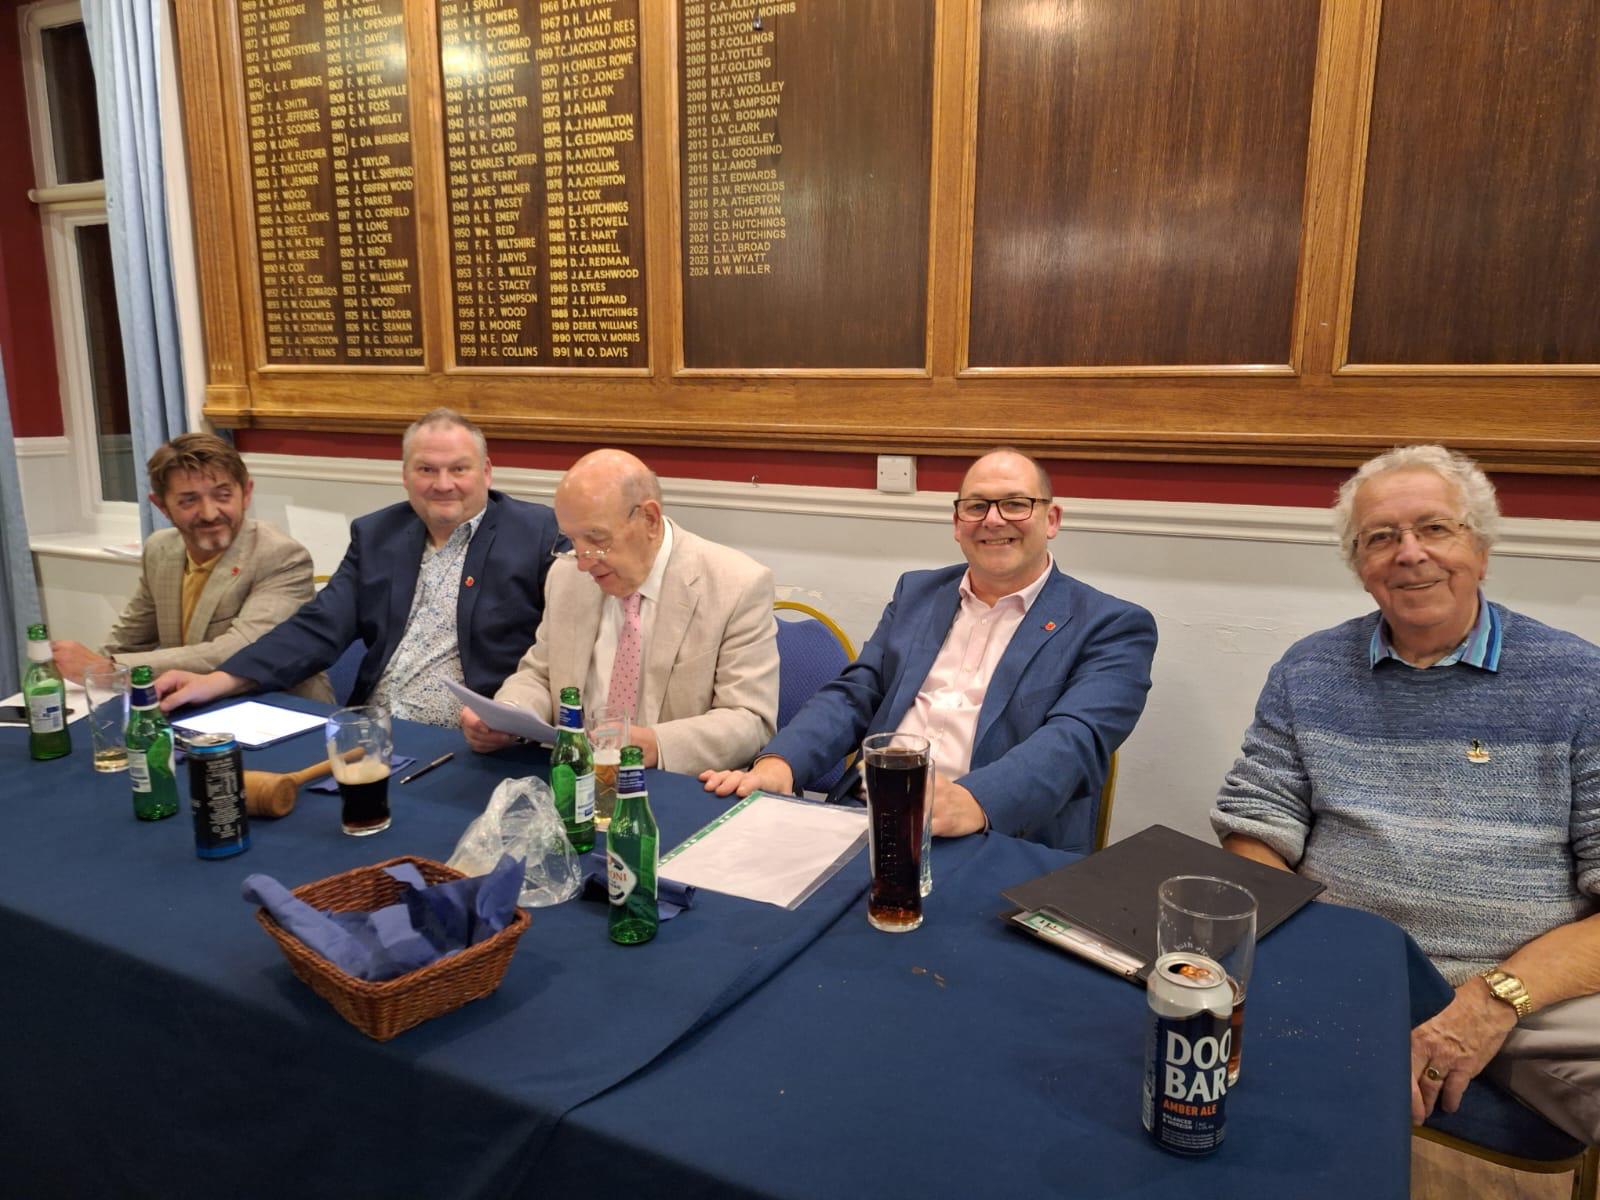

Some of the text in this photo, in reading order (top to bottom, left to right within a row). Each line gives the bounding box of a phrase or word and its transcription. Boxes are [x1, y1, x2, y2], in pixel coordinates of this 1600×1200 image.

[586, 8, 612, 22] LANE
[686, 4, 705, 16] 2002
[686, 2, 796, 28] 2003 ANTHONY MORRIS
[614, 19, 635, 33] REES
[686, 28, 705, 40] 2004
[608, 35, 636, 50] JONES
[686, 42, 705, 53] 2005
[609, 53, 634, 66] ROWE
[686, 54, 706, 65] 2006
[273, 61, 292, 72] LONG
[687, 67, 706, 78] 2007
[592, 68, 624, 82] JONES
[290, 76, 322, 89] EDWARDS
[687, 80, 706, 90] 2008
[489, 84, 514, 96] OWEN
[687, 92, 706, 102] 2009
[737, 81, 784, 95] WOOLLEY
[490, 96, 528, 110] DUNSTER
[688, 103, 707, 114] 2010
[734, 95, 780, 109] SAMPSON
[491, 112, 516, 124] AMOR
[688, 116, 705, 126] 2011
[736, 108, 777, 121] BODMAN
[491, 127, 515, 138] FORD
[688, 128, 707, 138] 2012
[728, 122, 760, 133] CLARK
[492, 142, 517, 154] CARD
[688, 140, 707, 150] 2013
[688, 152, 707, 162] 2014
[732, 144, 782, 158] GOODHIND
[362, 156, 390, 167] TAYLOR
[471, 157, 505, 170] CHARLES
[508, 154, 537, 166] PORTER
[688, 164, 708, 174] 2015
[689, 176, 708, 186] 2016
[731, 170, 776, 182] EDWARDS
[689, 188, 708, 197] 2017
[735, 181, 785, 194] REYNOLDS
[689, 200, 708, 209] 2018
[731, 194, 780, 206] ATHERTON
[689, 211, 708, 220] 2019
[734, 206, 781, 217] CHAPMAN
[591, 216, 628, 228] POWELL
[689, 223, 708, 231] 2020
[733, 218, 786, 229] HUTCHINGS
[496, 225, 515, 236] REID
[592, 230, 617, 239] HART
[690, 234, 708, 243] 2021
[733, 230, 786, 240] HUTCHINGS
[496, 238, 536, 249] WILTSHIRE
[579, 244, 620, 254] CARNELL
[690, 245, 709, 254] 2022
[738, 242, 771, 252] BROAD
[497, 253, 527, 262] JARVIS
[589, 257, 629, 267] REDMAN
[690, 253, 766, 265] 2023 WYATT
[509, 266, 536, 276] WILLEY
[690, 265, 771, 276] 2024 MILLER
[499, 280, 530, 290] STACEY
[581, 283, 606, 291] SYKES
[500, 294, 538, 303] SAMPSON
[590, 295, 627, 304] UPWARD
[500, 307, 526, 317] WOOD
[591, 308, 638, 317] HUTCHINGS
[490, 321, 521, 330] MOORE
[573, 322, 597, 330] DEREK
[600, 321, 638, 330] WILLIAMS
[502, 334, 518, 343] DAY
[573, 334, 600, 342] VICTOR
[611, 333, 640, 342] MORRIS
[502, 347, 538, 356] COLLINS
[553, 348, 570, 356] 1991
[601, 348, 628, 357] DAVIS
[1164, 1064, 1227, 1102] BAR
[1163, 1100, 1217, 1116] AMBER ALE
